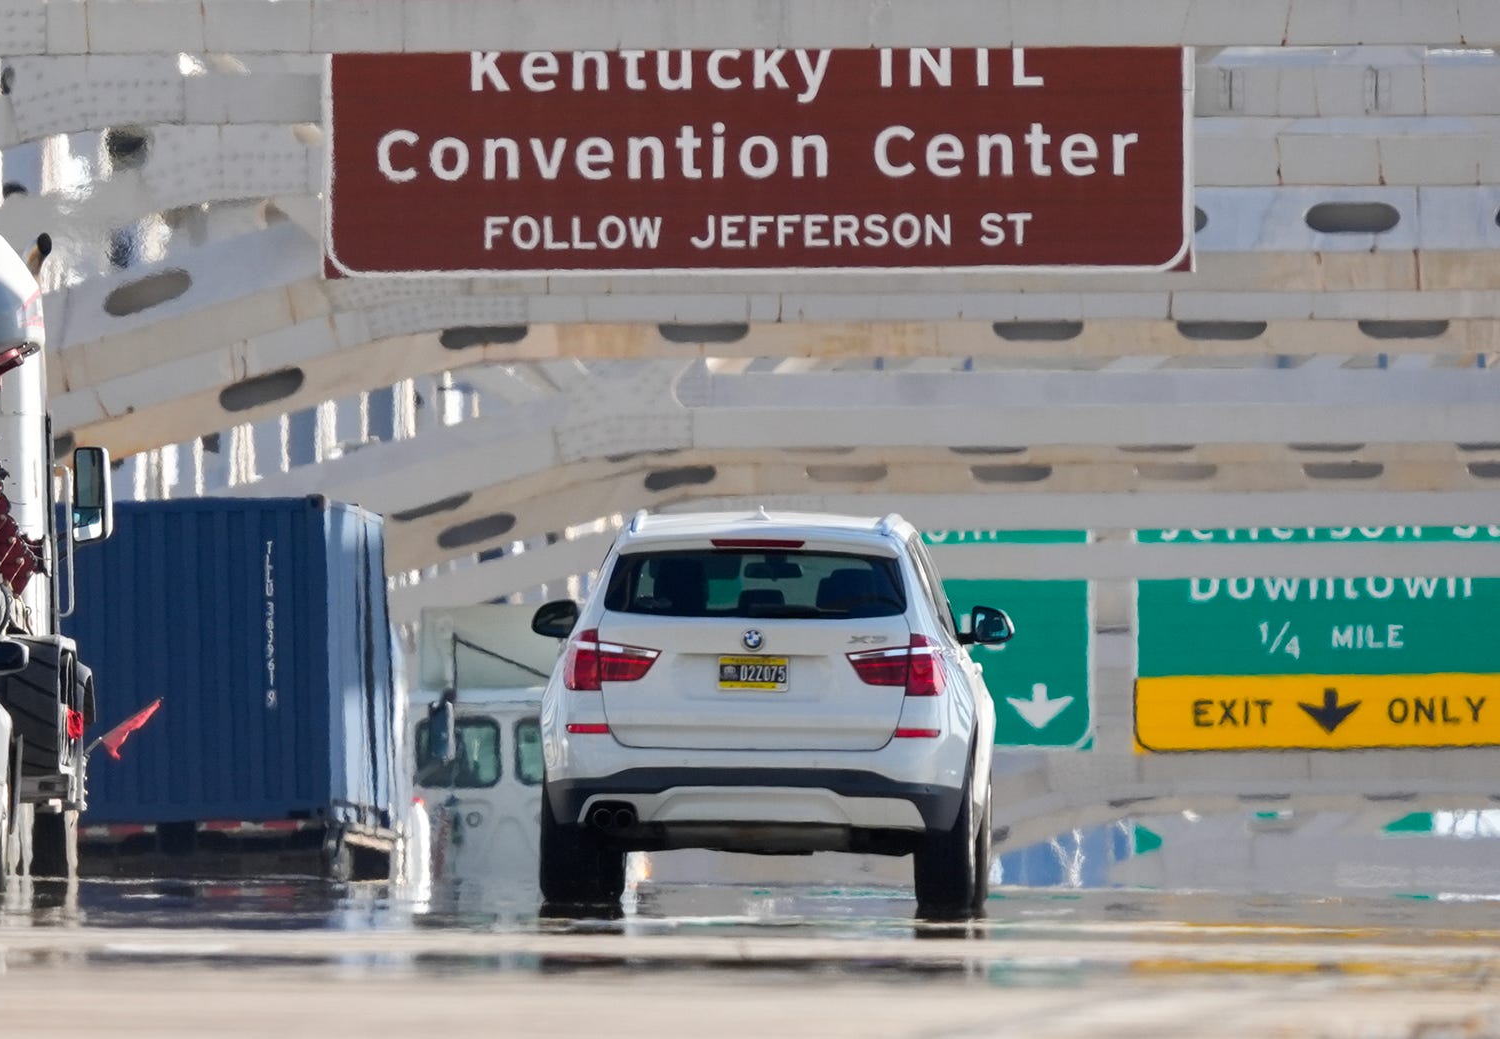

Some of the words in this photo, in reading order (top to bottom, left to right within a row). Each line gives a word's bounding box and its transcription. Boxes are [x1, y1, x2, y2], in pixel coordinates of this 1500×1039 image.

[469, 49, 831, 104] Kentucky
[376, 122, 829, 184] Convention
[874, 122, 1139, 178] Center
[483, 215, 663, 251] FOLLOW
[690, 212, 952, 250] JEFFERSON
[980, 212, 1033, 247] ST
[1331, 624, 1404, 649] MILE
[1193, 699, 1273, 727] EXIT
[1387, 697, 1486, 724] ONLY
